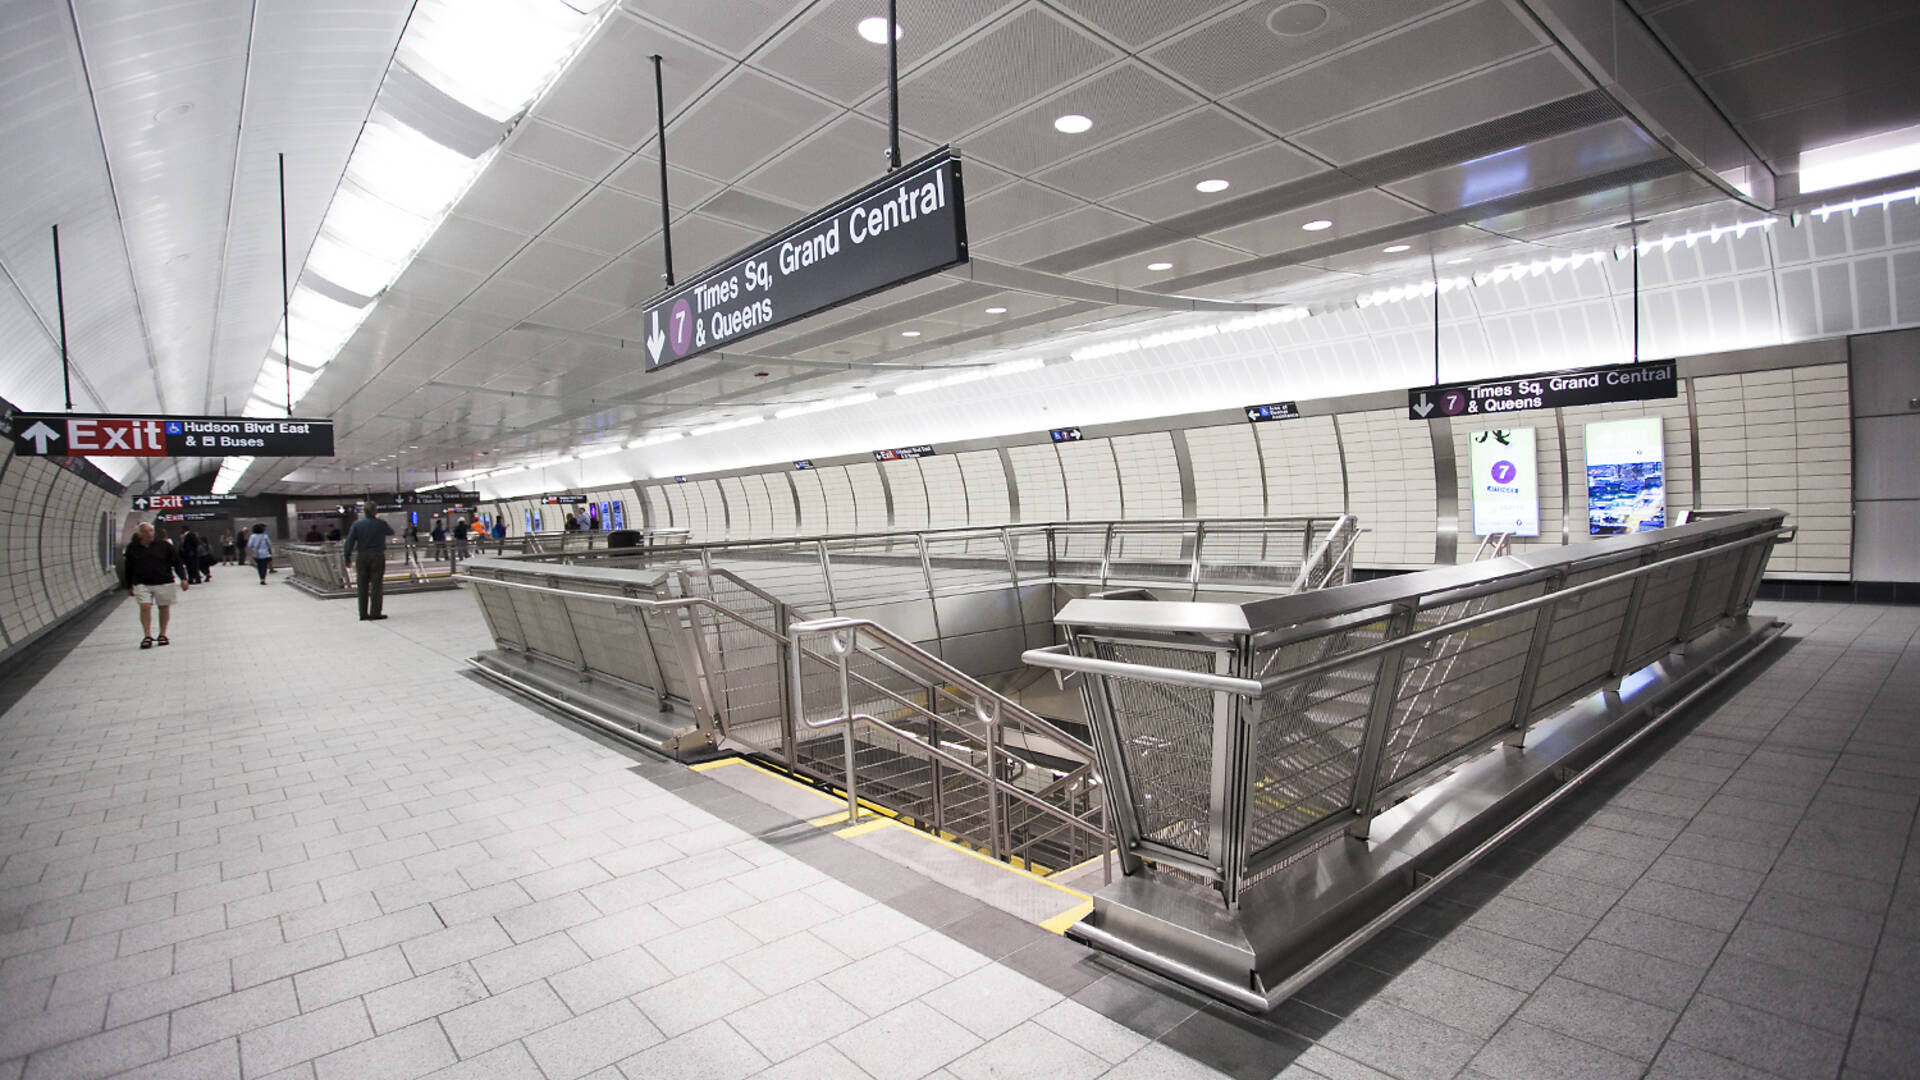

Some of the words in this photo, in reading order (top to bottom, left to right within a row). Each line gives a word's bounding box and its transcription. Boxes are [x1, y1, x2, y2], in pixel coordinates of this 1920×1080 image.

[694, 274, 738, 313] Times
[745, 260, 773, 293] Sq,
[779, 219, 840, 276] Grand
[849, 169, 946, 245] Central
[675, 311, 686, 344] 7
[695, 318, 706, 347] &
[711, 298, 773, 340] Queens
[1467, 386, 1512, 399] Times
[1518, 381, 1544, 396] Sq,
[1549, 374, 1599, 391] Grand
[1606, 366, 1671, 385] Central
[1446, 395, 1458, 410] 7
[1467, 400, 1479, 413] &
[1485, 397, 1542, 411] Queens
[67, 420, 163, 450] Exit
[184, 422, 239, 433] Hudson
[245, 423, 275, 433] Blvd
[279, 423, 310, 434] East
[185, 436, 196, 446] &
[220, 436, 264, 447] Buses
[1499, 465, 1510, 479] 7
[150, 496, 183, 508] Exit
